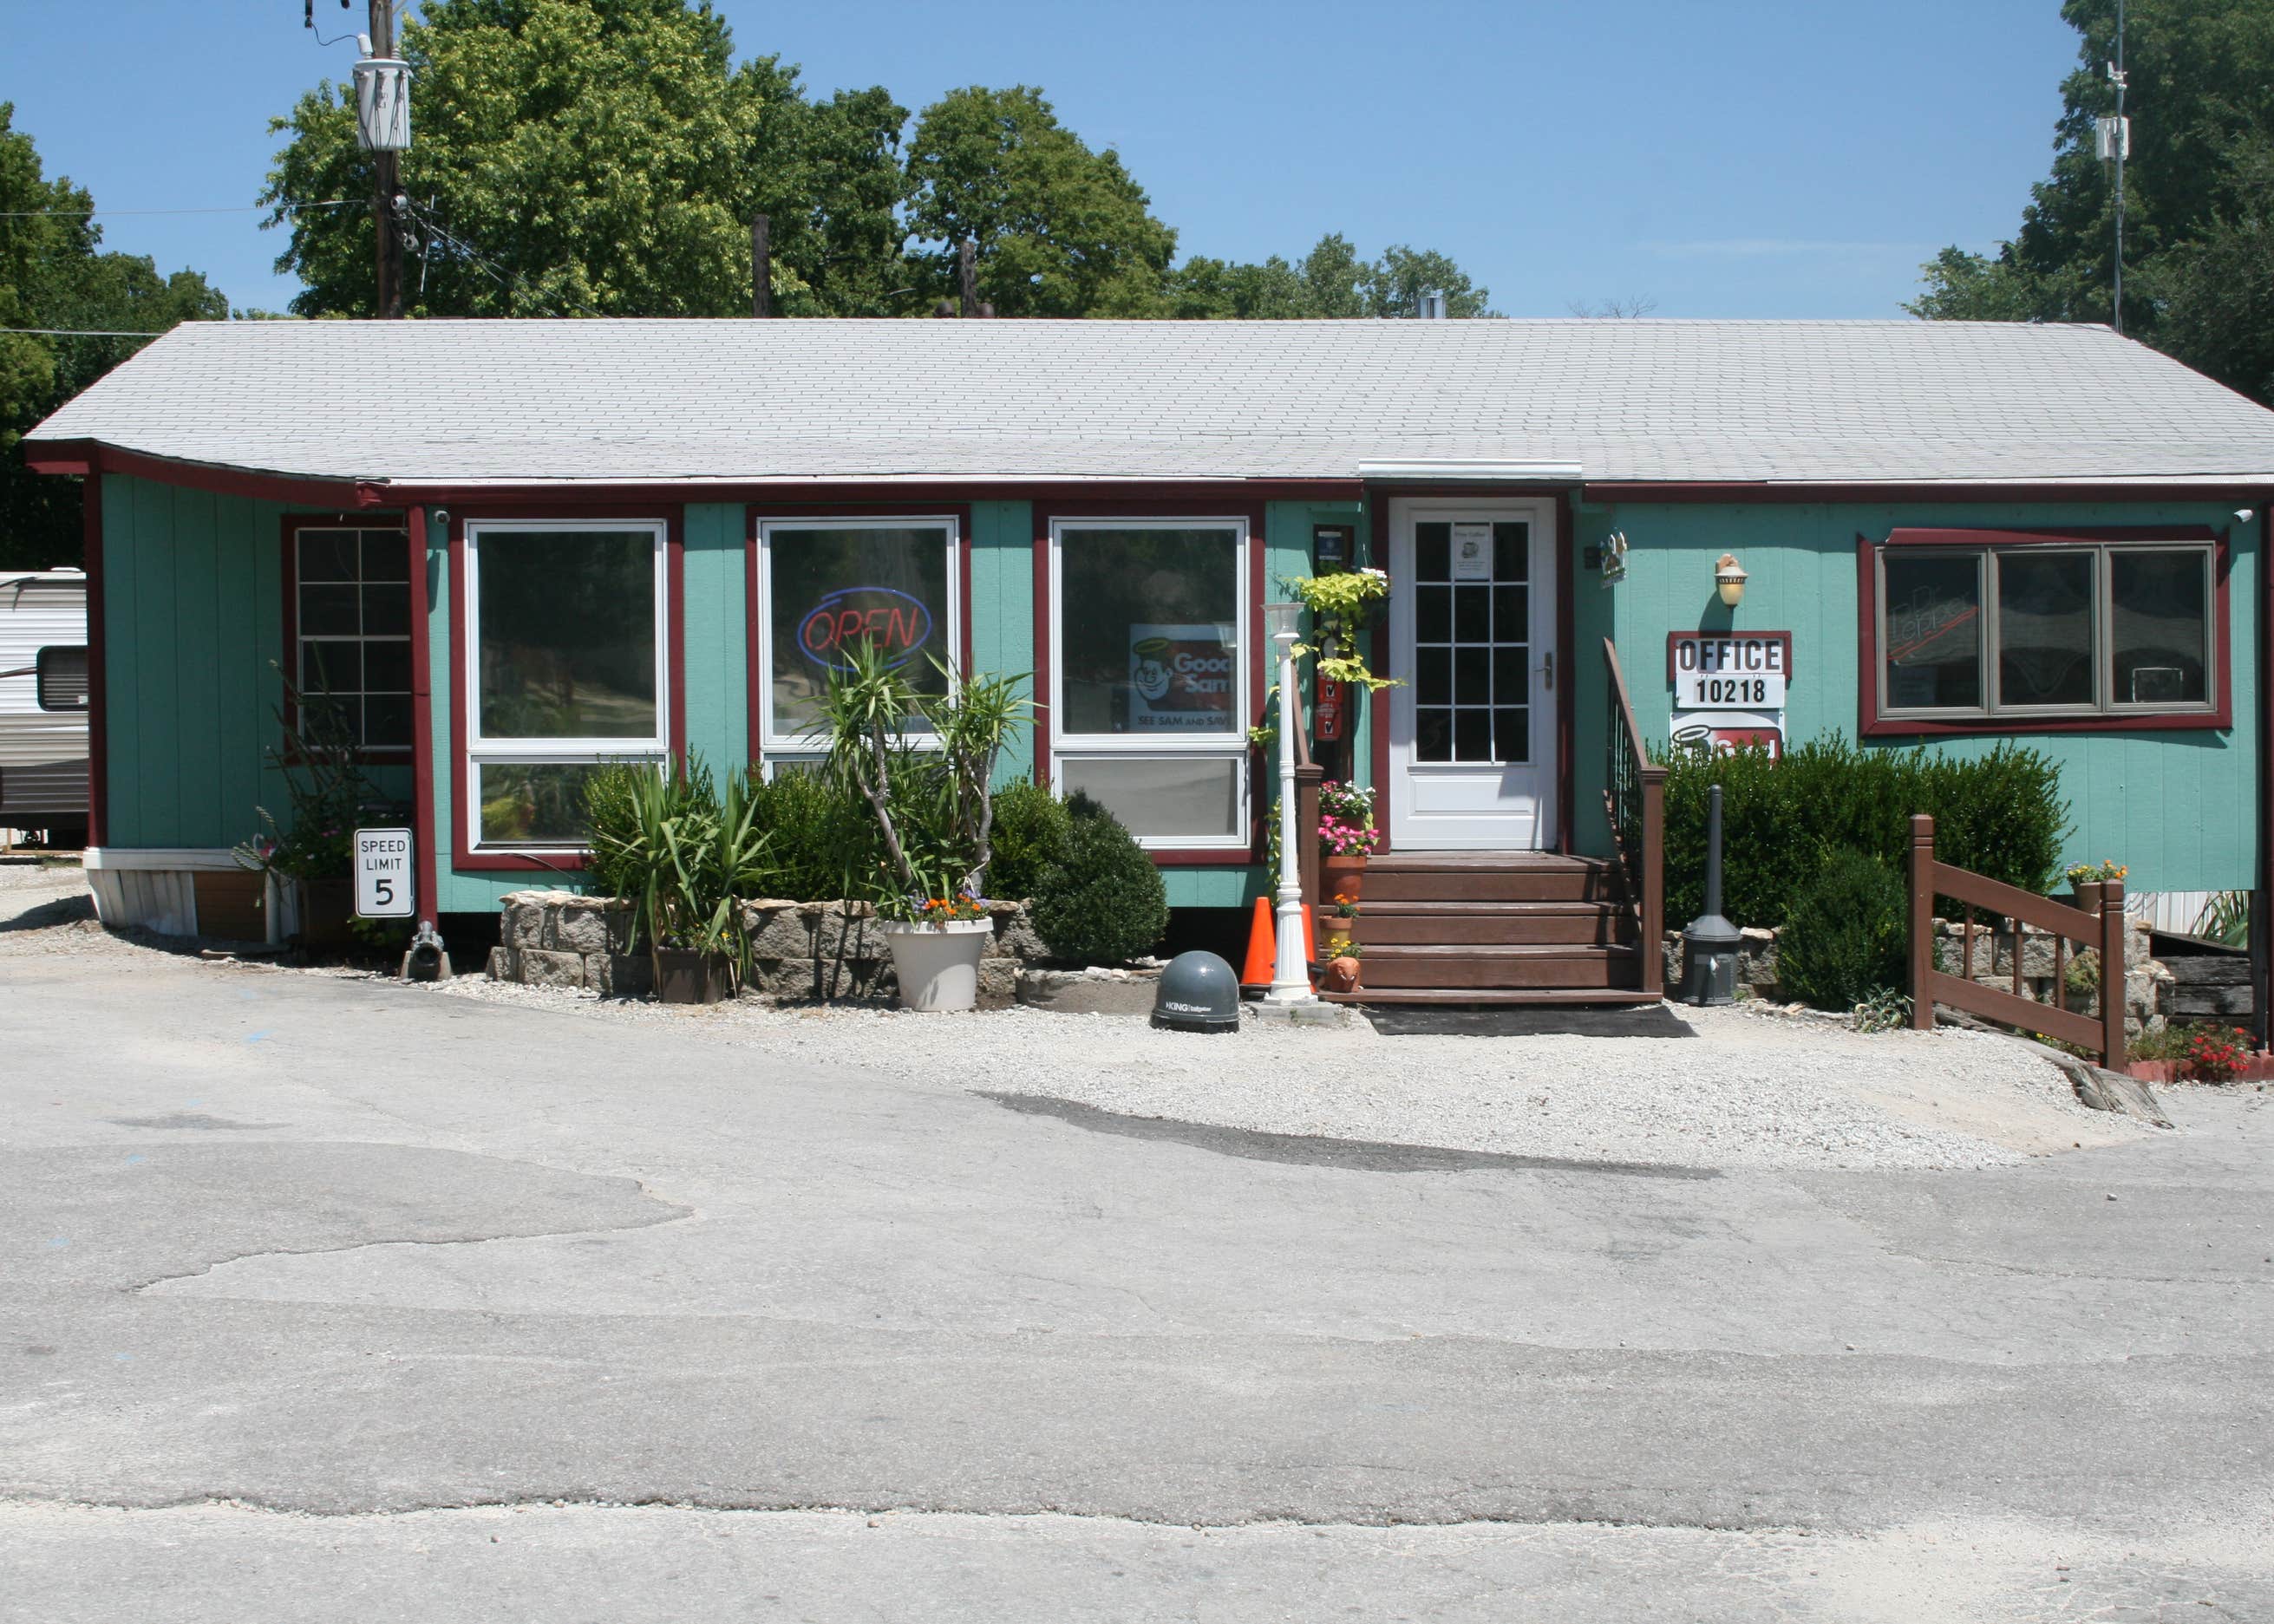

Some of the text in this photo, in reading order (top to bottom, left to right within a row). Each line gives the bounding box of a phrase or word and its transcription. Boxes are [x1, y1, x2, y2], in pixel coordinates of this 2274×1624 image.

[805, 607, 918, 651] OPEN
[1679, 640, 1781, 671] OFFICE
[1696, 679, 1765, 703] 10218
[1138, 714, 1228, 727] SEE SAM AND SAV
[361, 840, 406, 852] SPEED
[366, 858, 402, 871] LIMIT
[376, 878, 394, 906] 5
[1168, 1001, 1189, 1012] KING
